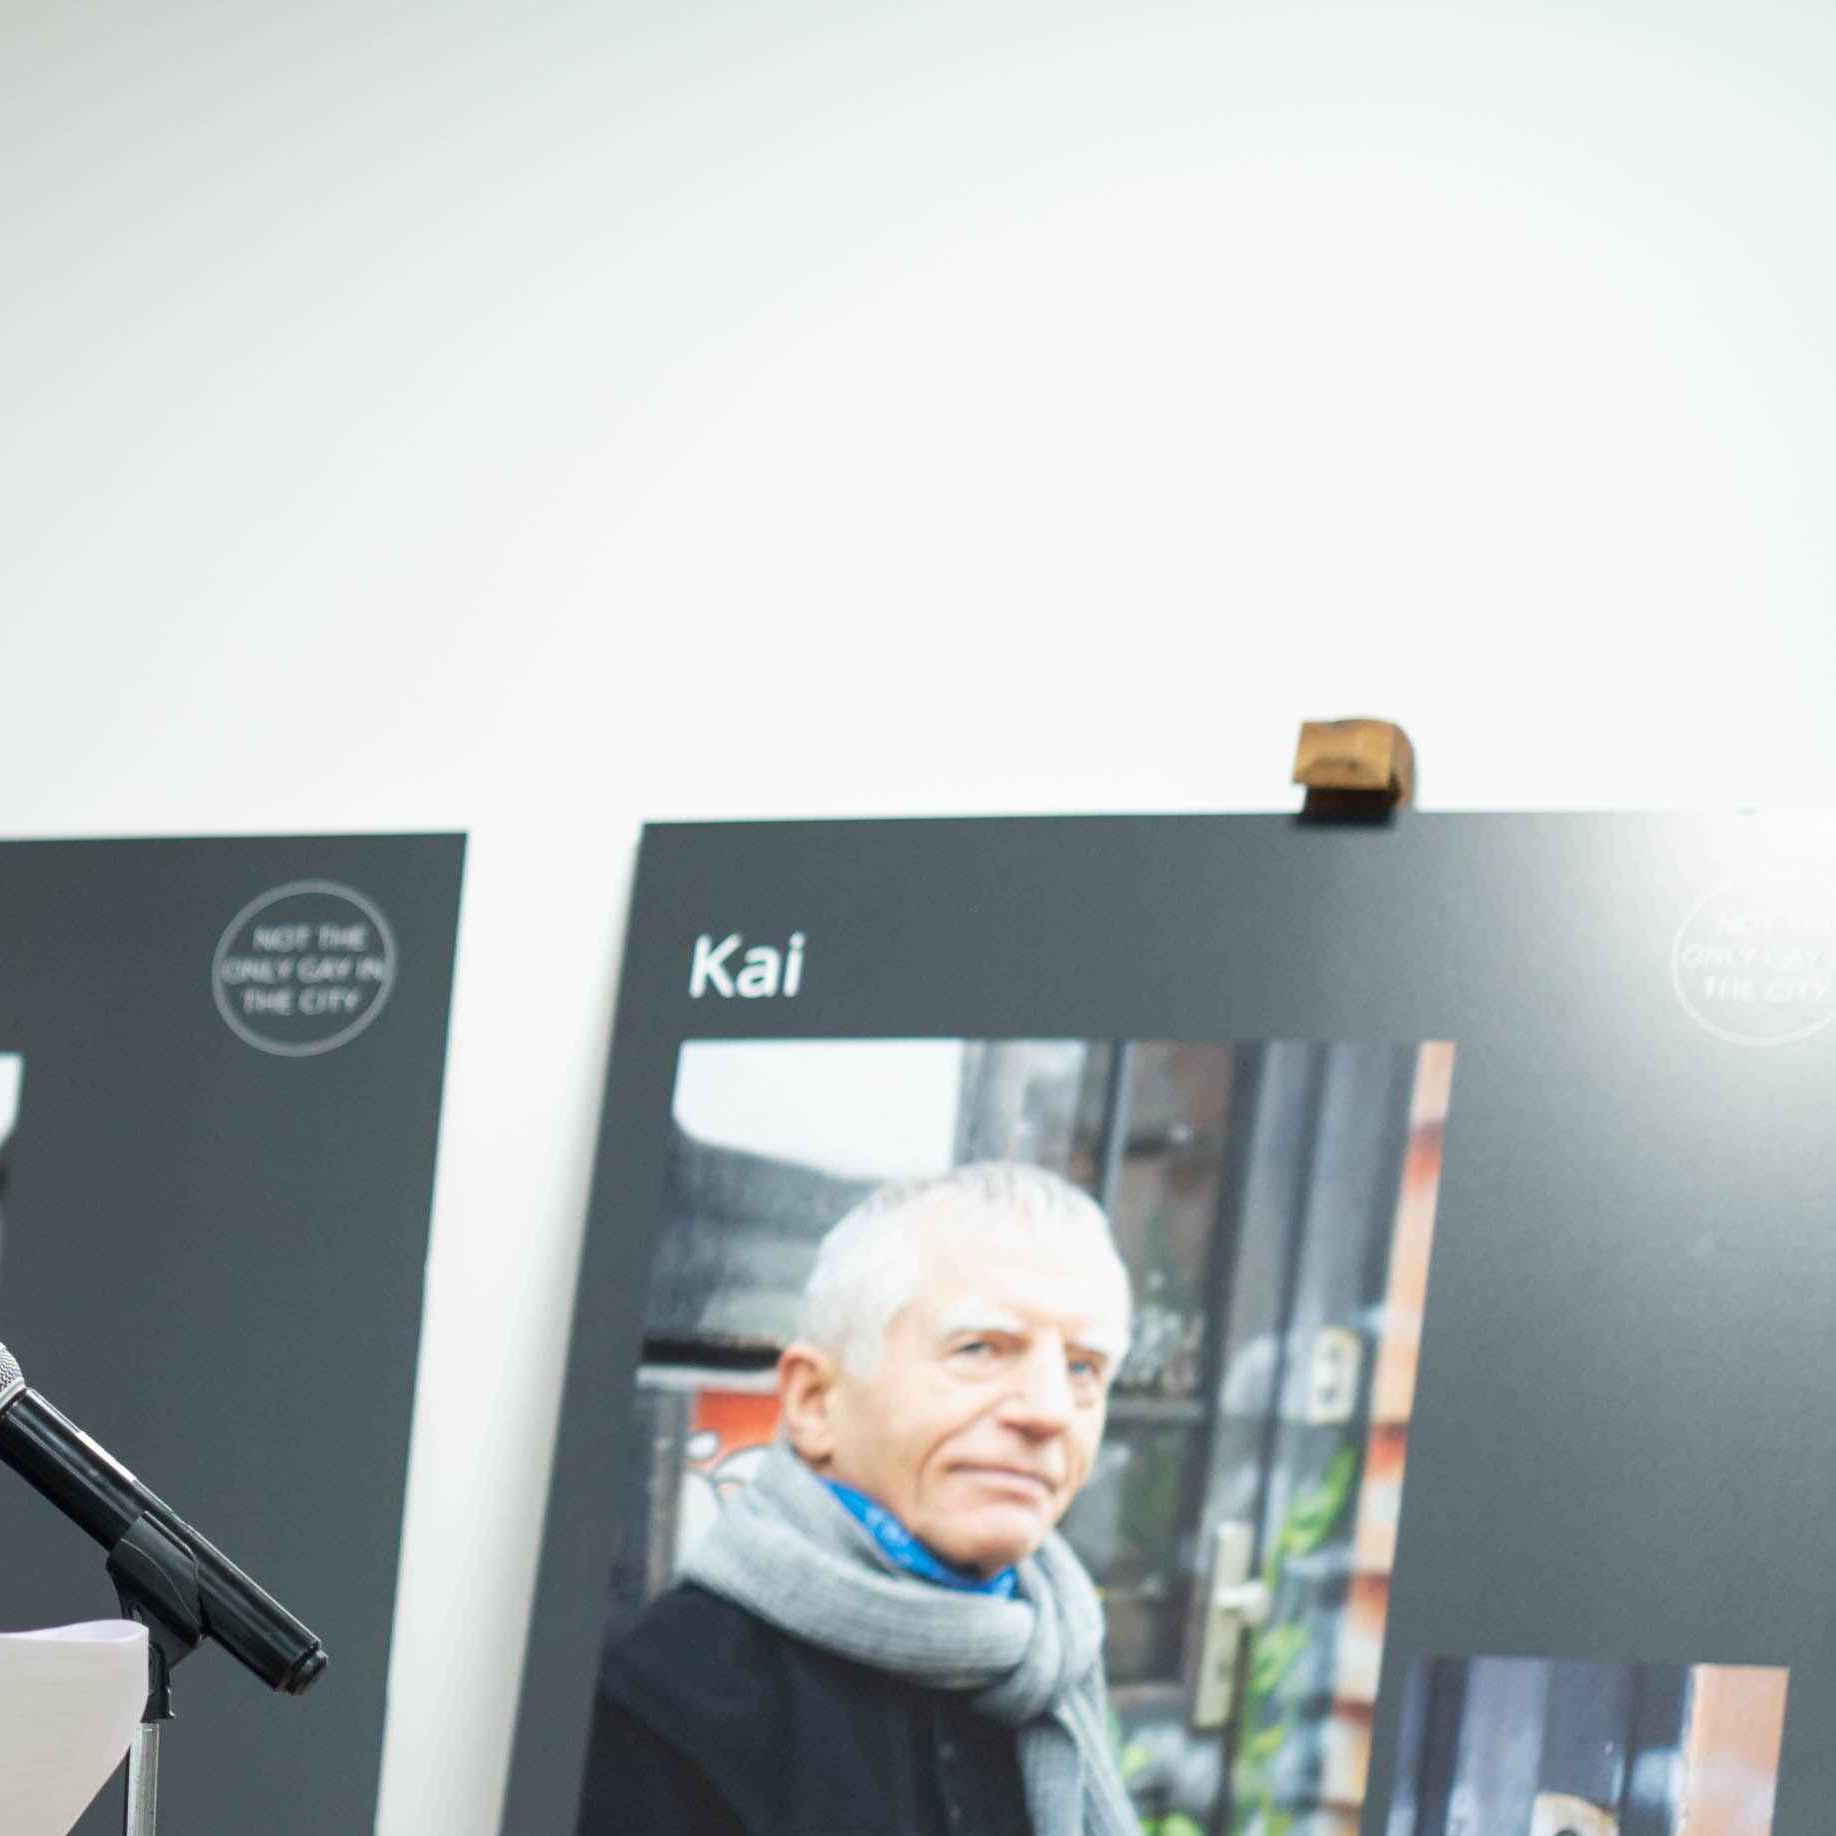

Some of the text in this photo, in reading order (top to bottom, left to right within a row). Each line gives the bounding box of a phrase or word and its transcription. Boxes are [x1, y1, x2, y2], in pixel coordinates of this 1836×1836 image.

[253, 923, 367, 952] NOT THE
[221, 956, 294, 984] ONLY
[297, 956, 352, 984] GAY
[689, 931, 806, 999] Kai
[243, 986, 359, 1015] THE CITY
